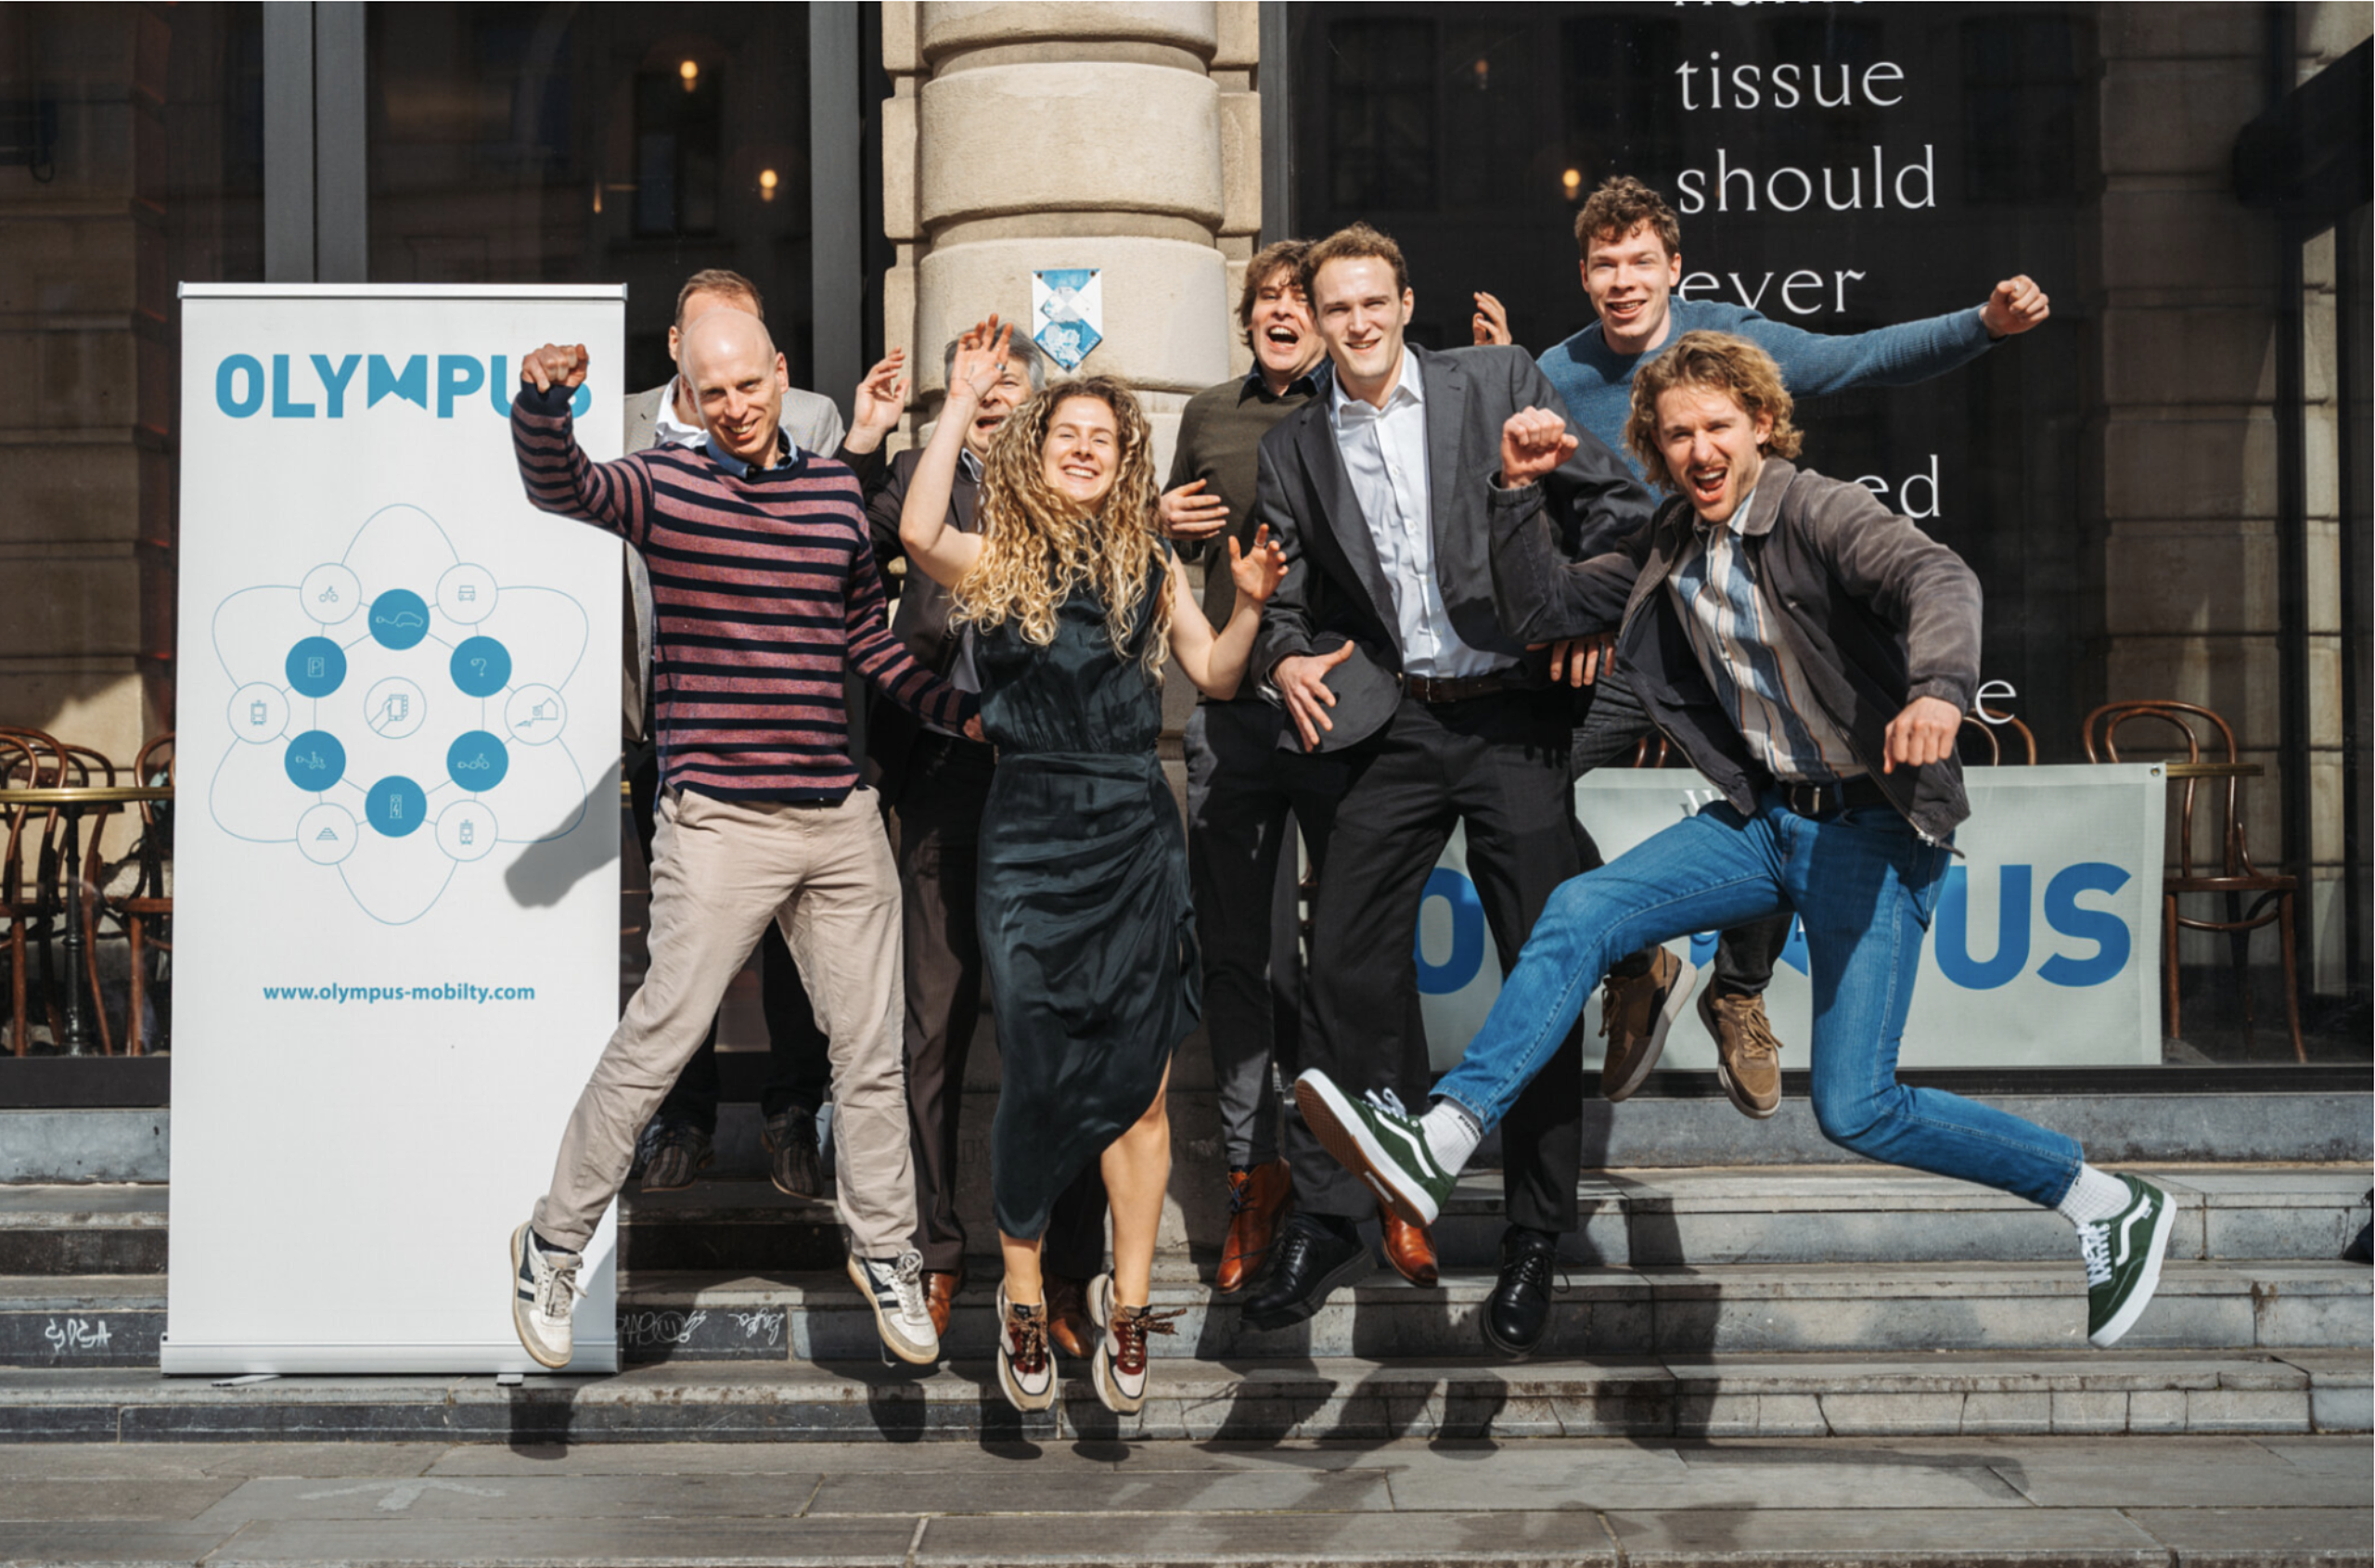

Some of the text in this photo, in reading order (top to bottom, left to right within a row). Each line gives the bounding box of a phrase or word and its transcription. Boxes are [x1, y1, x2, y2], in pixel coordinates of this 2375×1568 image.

[1675, 51, 1906, 110] tissue
[1676, 144, 1937, 215] should
[1677, 268, 1866, 315] ever
[1853, 453, 1941, 520] ed
[263, 982, 535, 1004] www.olympus-mobilty.com
